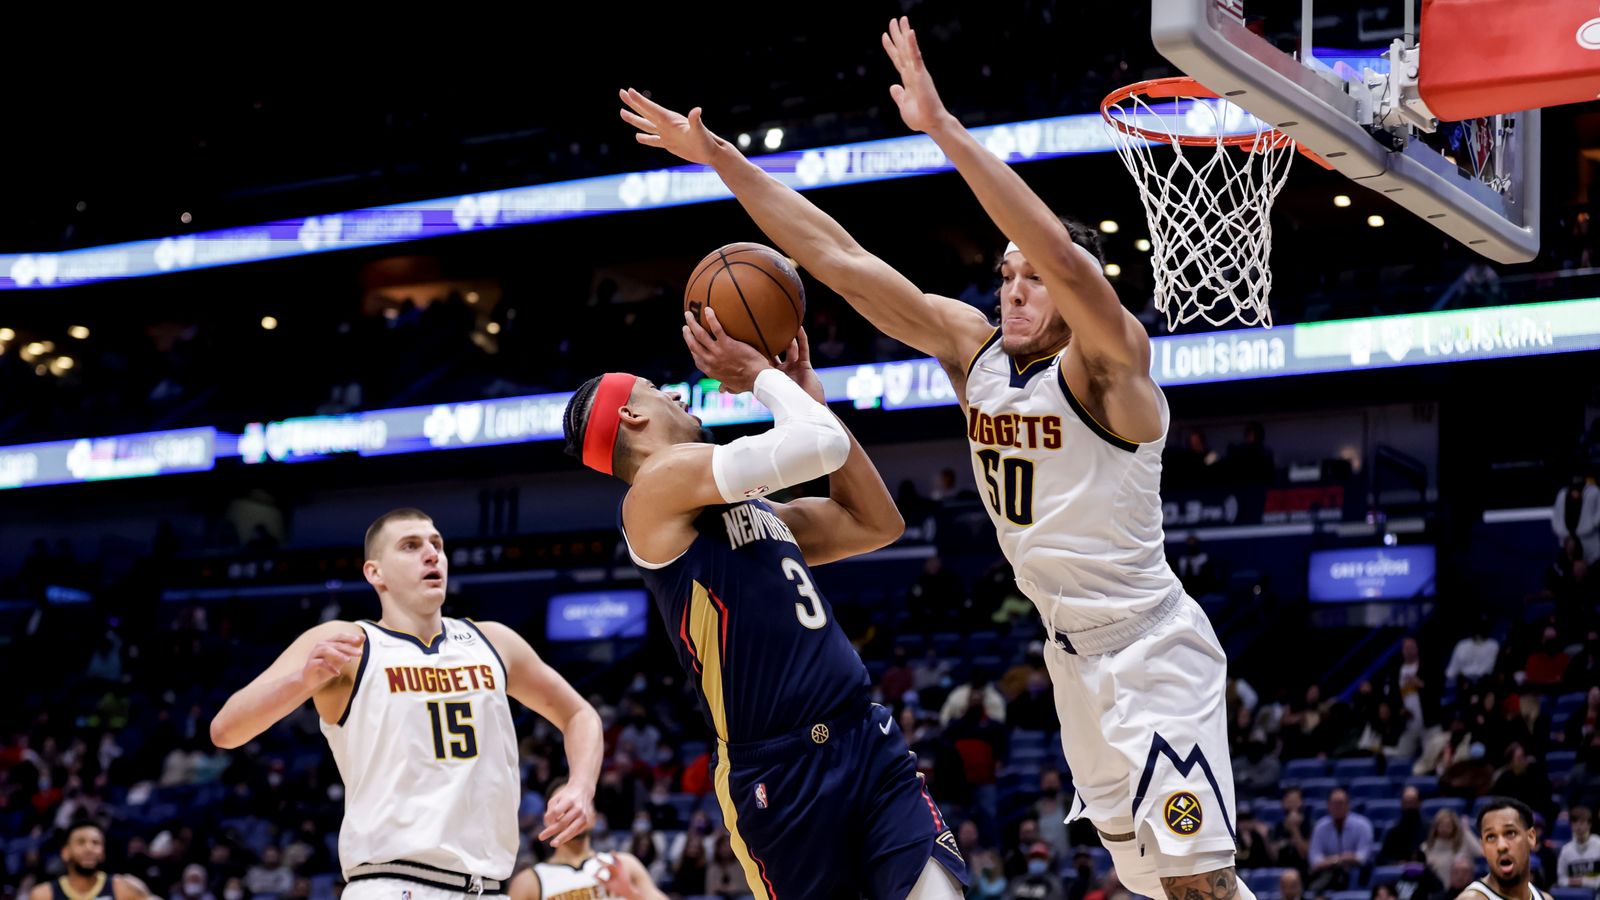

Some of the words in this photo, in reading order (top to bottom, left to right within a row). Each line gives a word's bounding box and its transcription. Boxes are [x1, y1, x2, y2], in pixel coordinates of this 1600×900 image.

[1162, 334, 1285, 379] Louisiana
[967, 406, 1063, 450] UGGETS
[976, 448, 1034, 527] 50
[722, 503, 767, 550] NEW
[781, 557, 827, 629] 3
[385, 664, 496, 694] NUGGETS
[426, 700, 479, 761] 15
